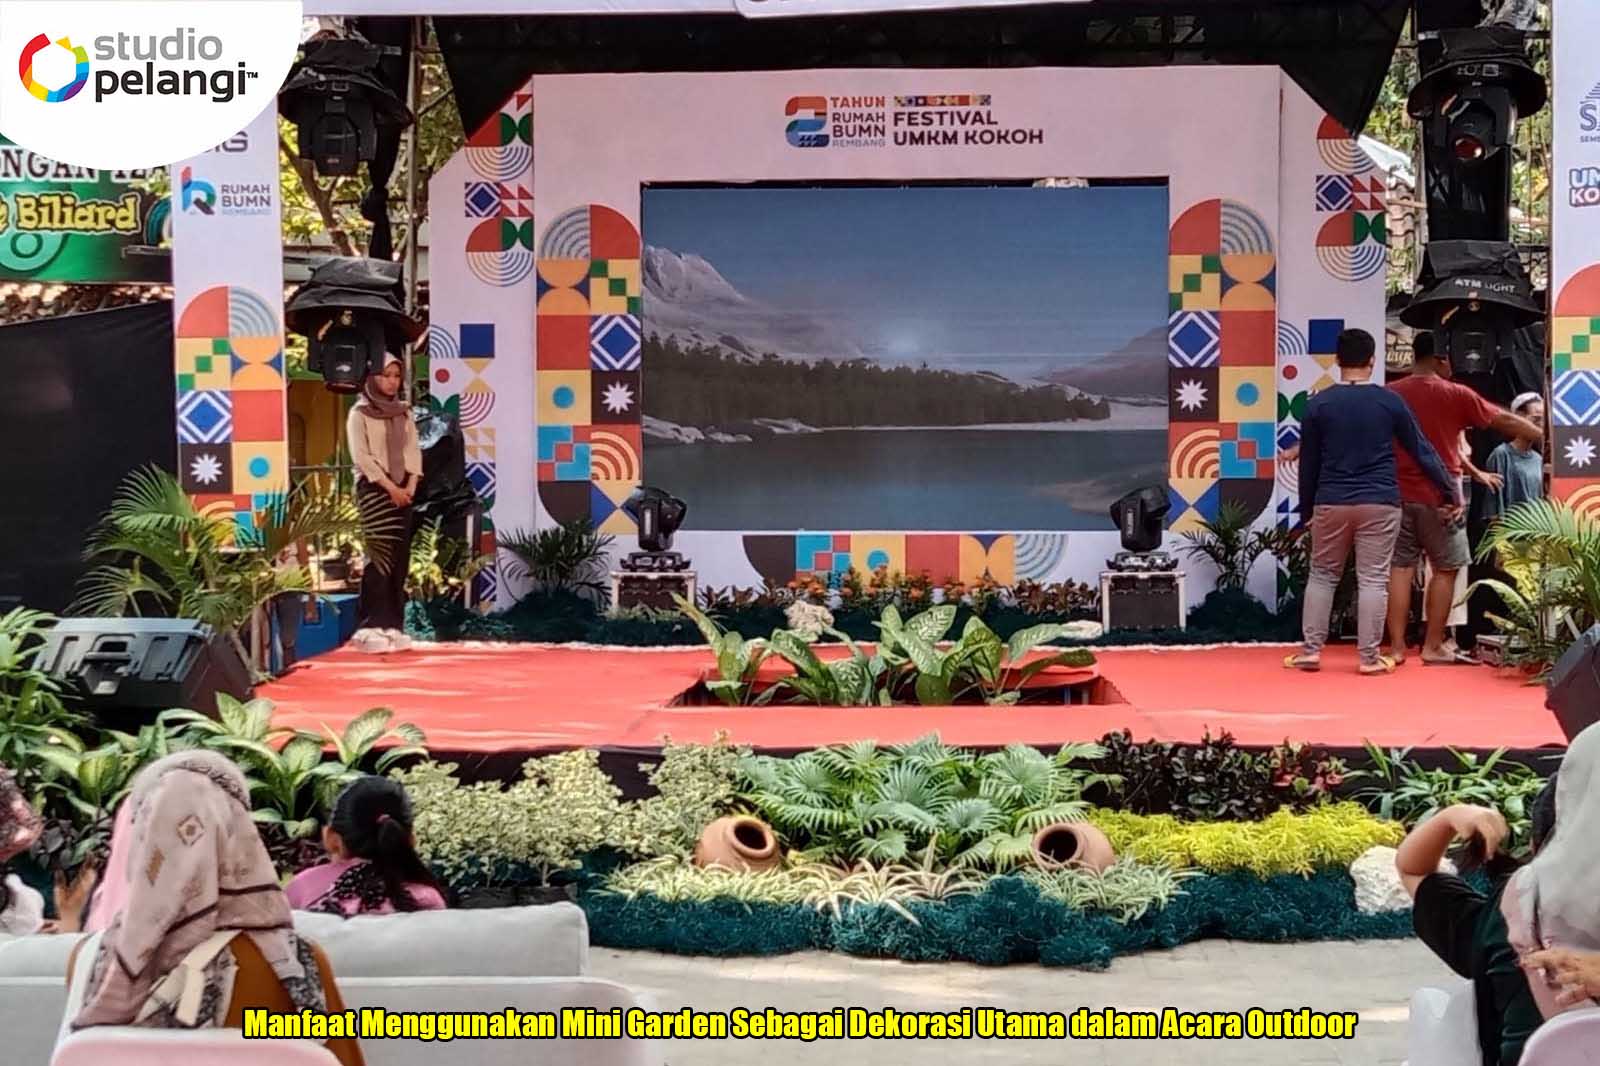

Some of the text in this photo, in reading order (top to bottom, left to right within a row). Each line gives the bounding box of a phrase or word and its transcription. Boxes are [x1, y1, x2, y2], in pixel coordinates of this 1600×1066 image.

[830, 96, 885, 108] TAHUN
[832, 112, 886, 123] RUMAH
[893, 110, 998, 127] FESTIVAL
[832, 124, 886, 138] BUMN
[893, 129, 1044, 146] UMKM KOKOH
[832, 139, 886, 148] REMBANG
[221, 184, 271, 194] RUMAH
[221, 195, 272, 208] BUMN
[15, 193, 139, 232] Biliard
[1455, 278, 1516, 294] ATM LIGHT
